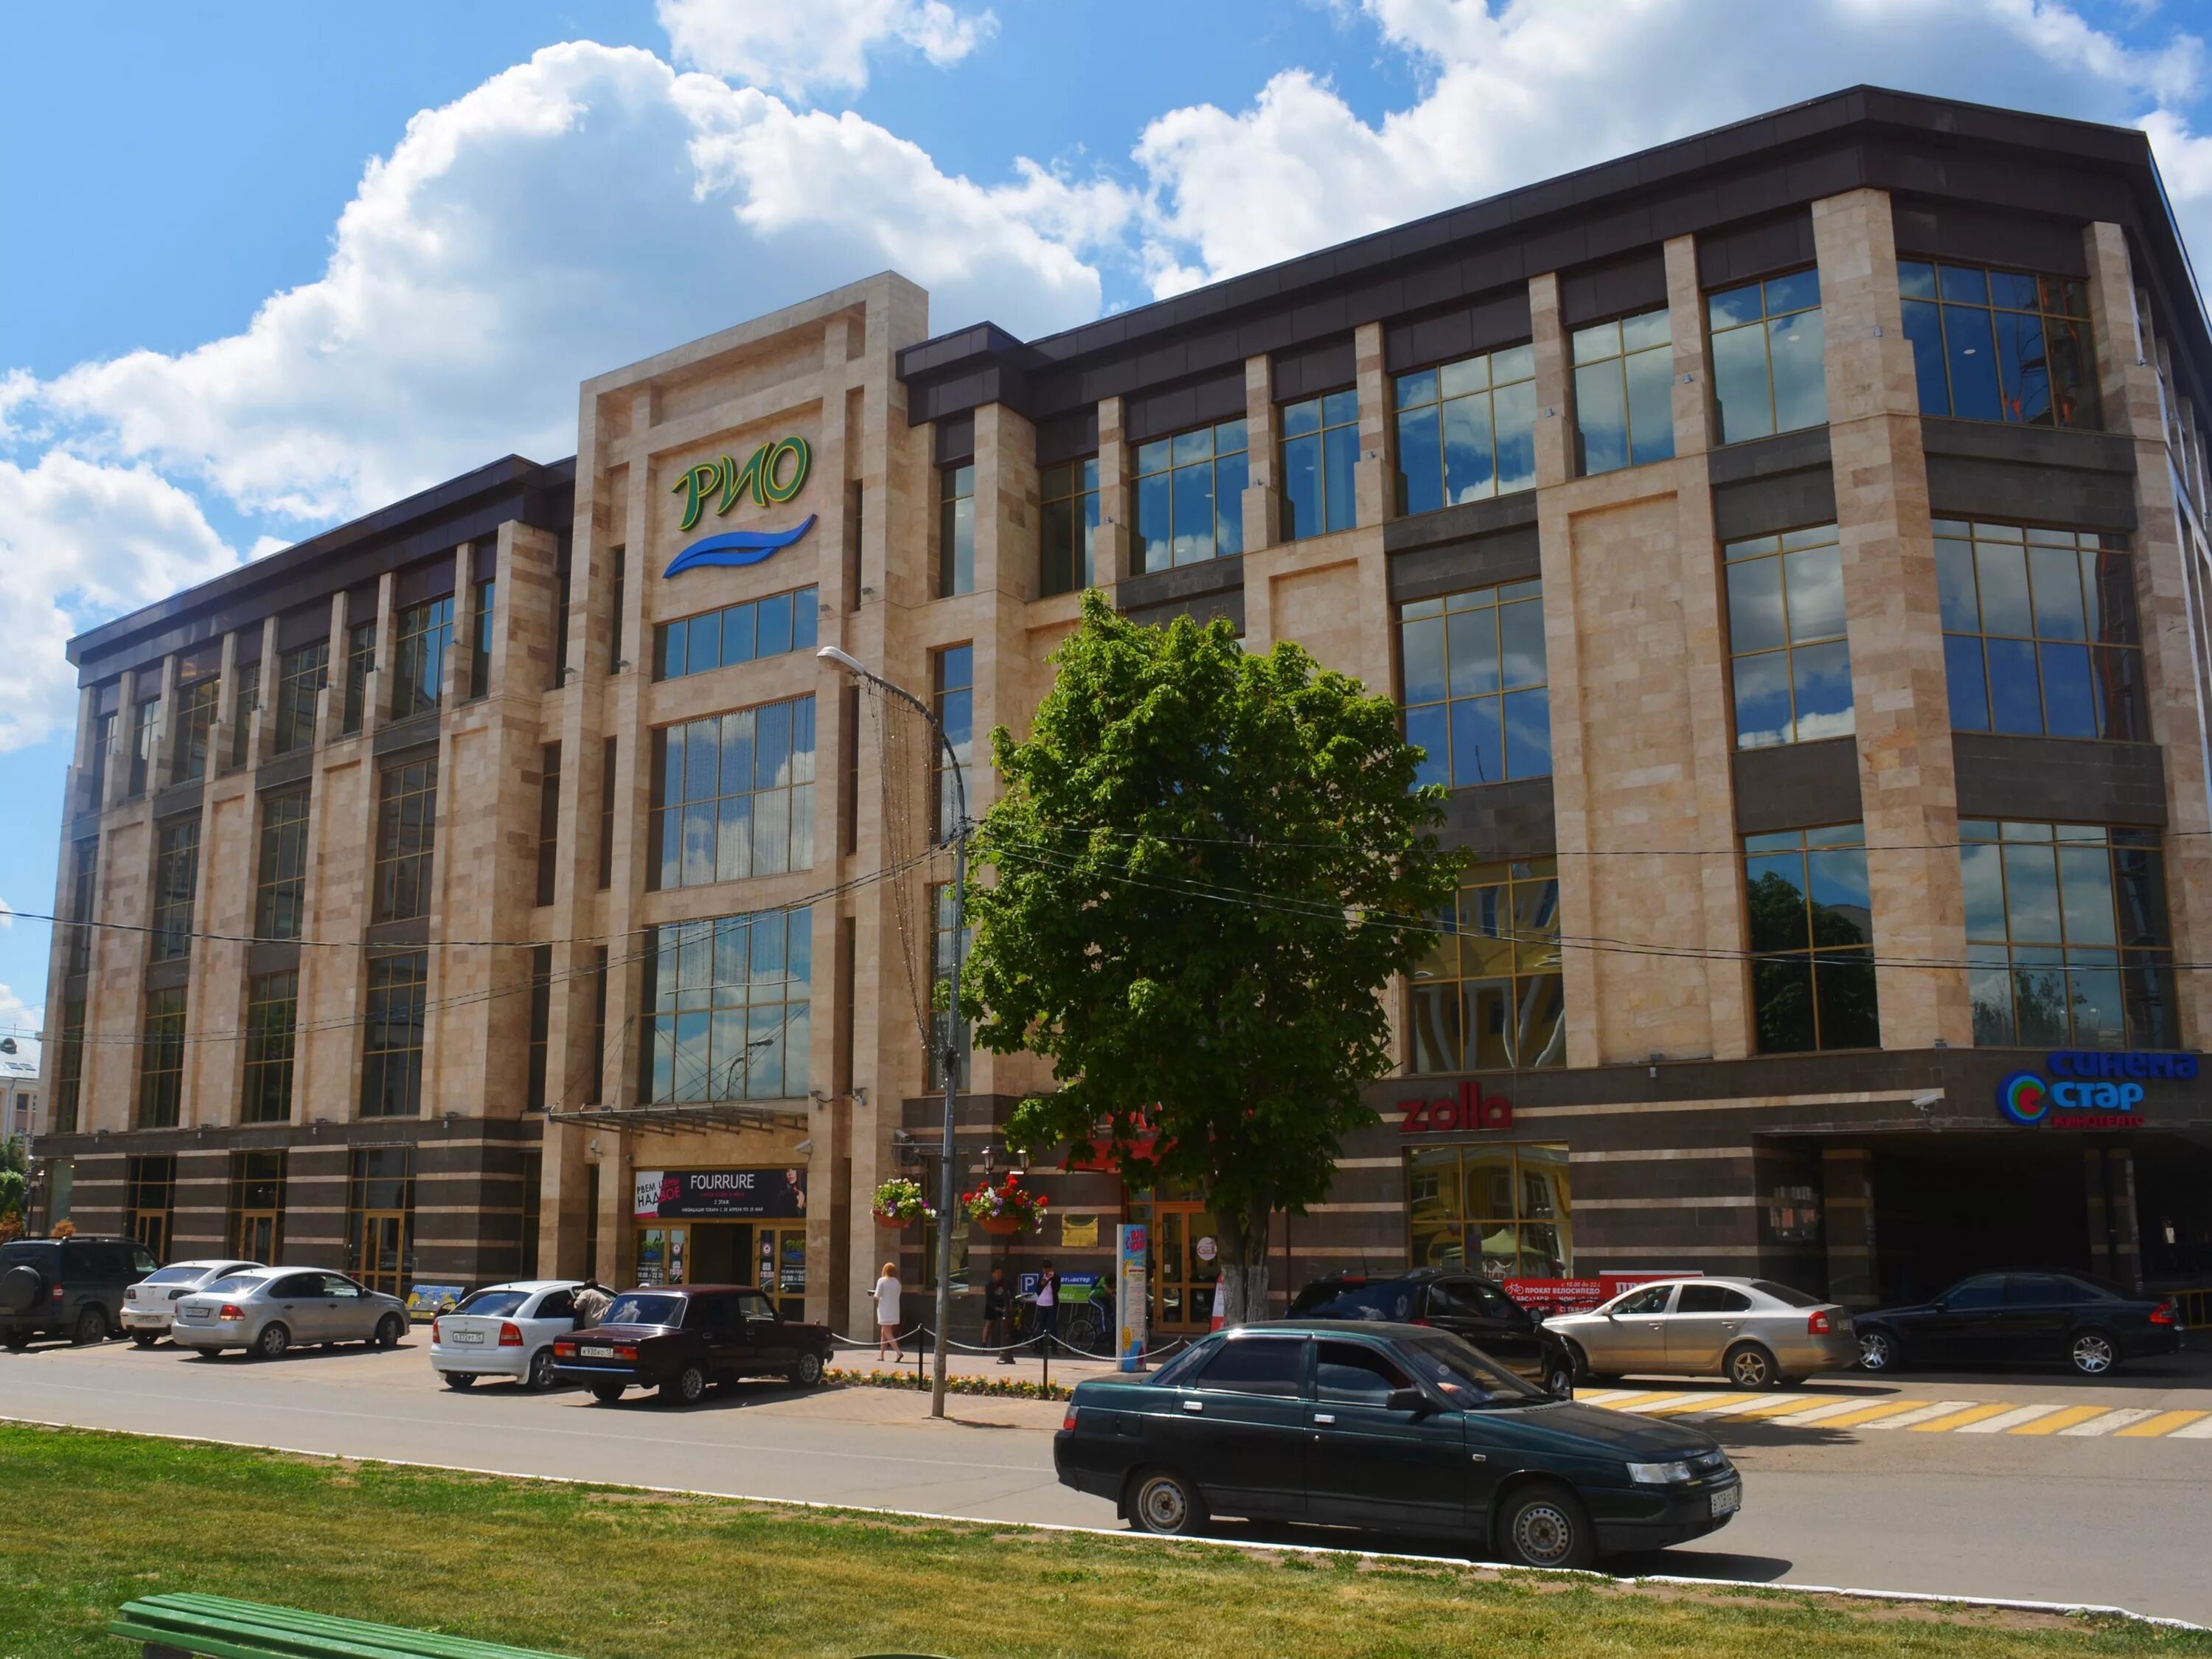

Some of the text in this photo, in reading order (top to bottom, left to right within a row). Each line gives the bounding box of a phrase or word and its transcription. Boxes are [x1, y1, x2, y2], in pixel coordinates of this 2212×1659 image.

[672, 435, 812, 531] РИО
[1397, 1081, 1512, 1133] zolla
[637, 1183, 655, 1194] РВЕМ
[690, 1174, 755, 1189] FOURRURE
[638, 1186, 681, 1207] НАДВОЕ
